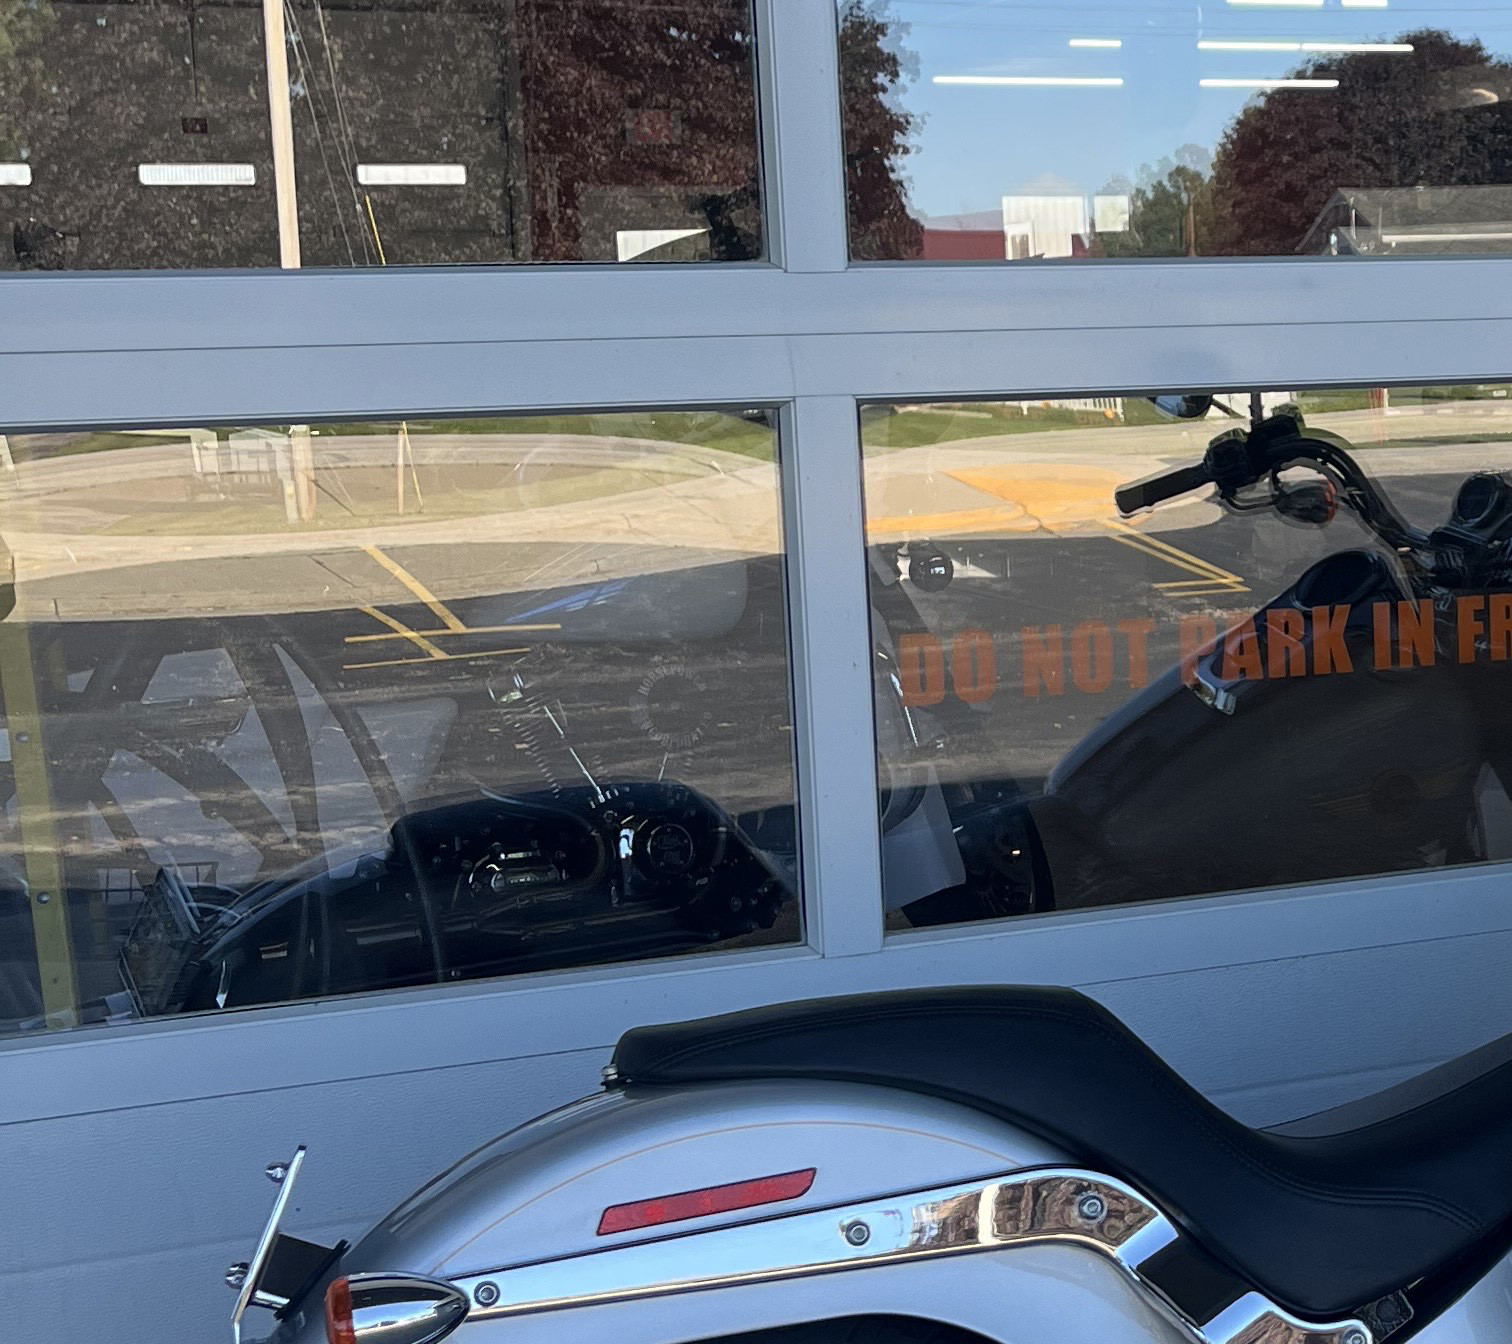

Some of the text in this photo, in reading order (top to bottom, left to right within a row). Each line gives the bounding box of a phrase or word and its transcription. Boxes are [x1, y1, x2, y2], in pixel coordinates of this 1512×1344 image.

[900, 628, 996, 706] DO
[1021, 618, 1157, 697] NOT
[1179, 604, 1354, 685] PARK
[1372, 599, 1436, 670] IN
